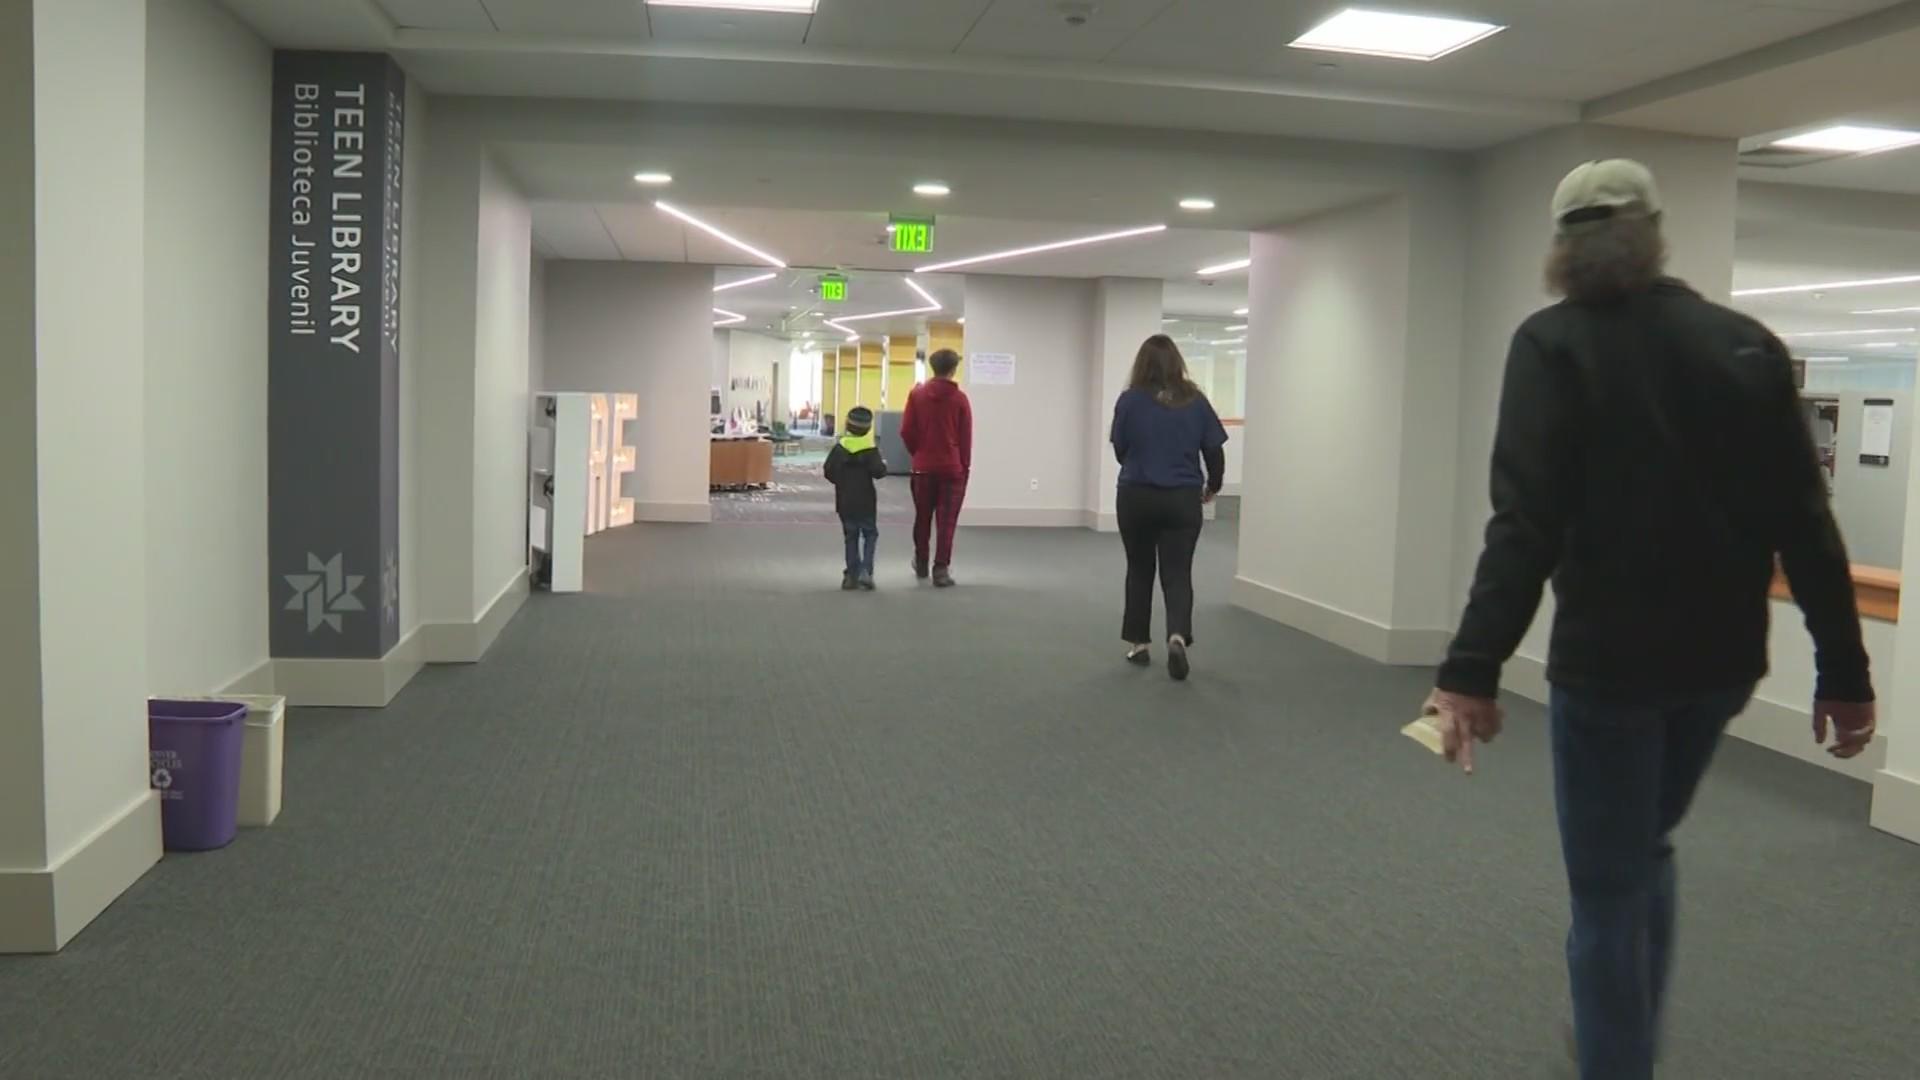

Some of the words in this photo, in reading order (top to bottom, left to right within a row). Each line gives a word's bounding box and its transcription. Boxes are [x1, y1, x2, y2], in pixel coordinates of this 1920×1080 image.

[293, 84, 319, 225] Biblioteca
[334, 84, 364, 178] TEEN
[291, 234, 316, 334] Juvenil
[330, 192, 362, 353] LIBRARY
